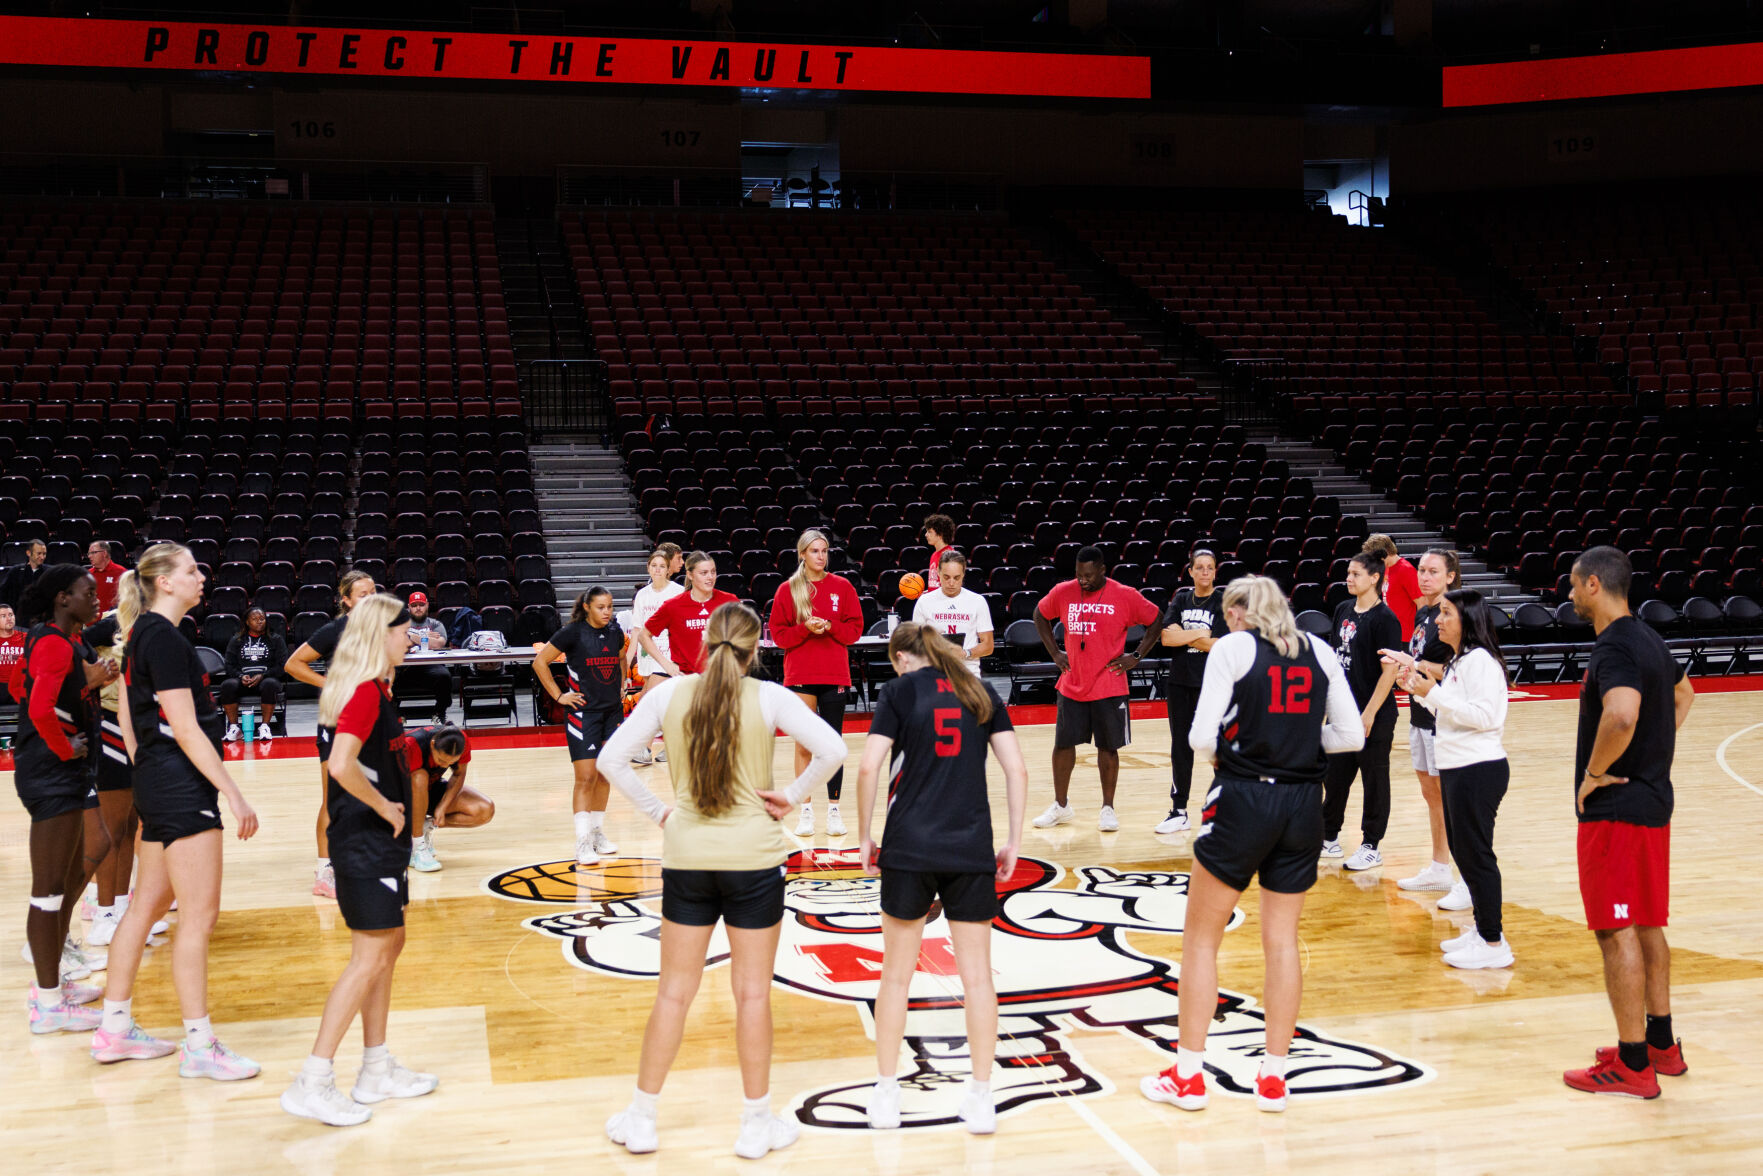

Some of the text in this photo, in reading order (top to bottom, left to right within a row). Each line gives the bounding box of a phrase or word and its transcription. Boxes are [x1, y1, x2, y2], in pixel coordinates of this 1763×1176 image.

[145, 28, 853, 84] PROTECT THE VAULT
[291, 121, 334, 138] 106
[661, 131, 700, 146] 107
[1553, 137, 1594, 153] 109
[1068, 603, 1115, 615] BUCKETS
[934, 613, 970, 621] NEBRASKA
[1068, 612, 1080, 622] BY
[948, 625, 957, 634] N
[936, 678, 955, 693] N
[1267, 665, 1313, 714] 12
[933, 707, 962, 757] 5
[1613, 903, 1629, 919] N
